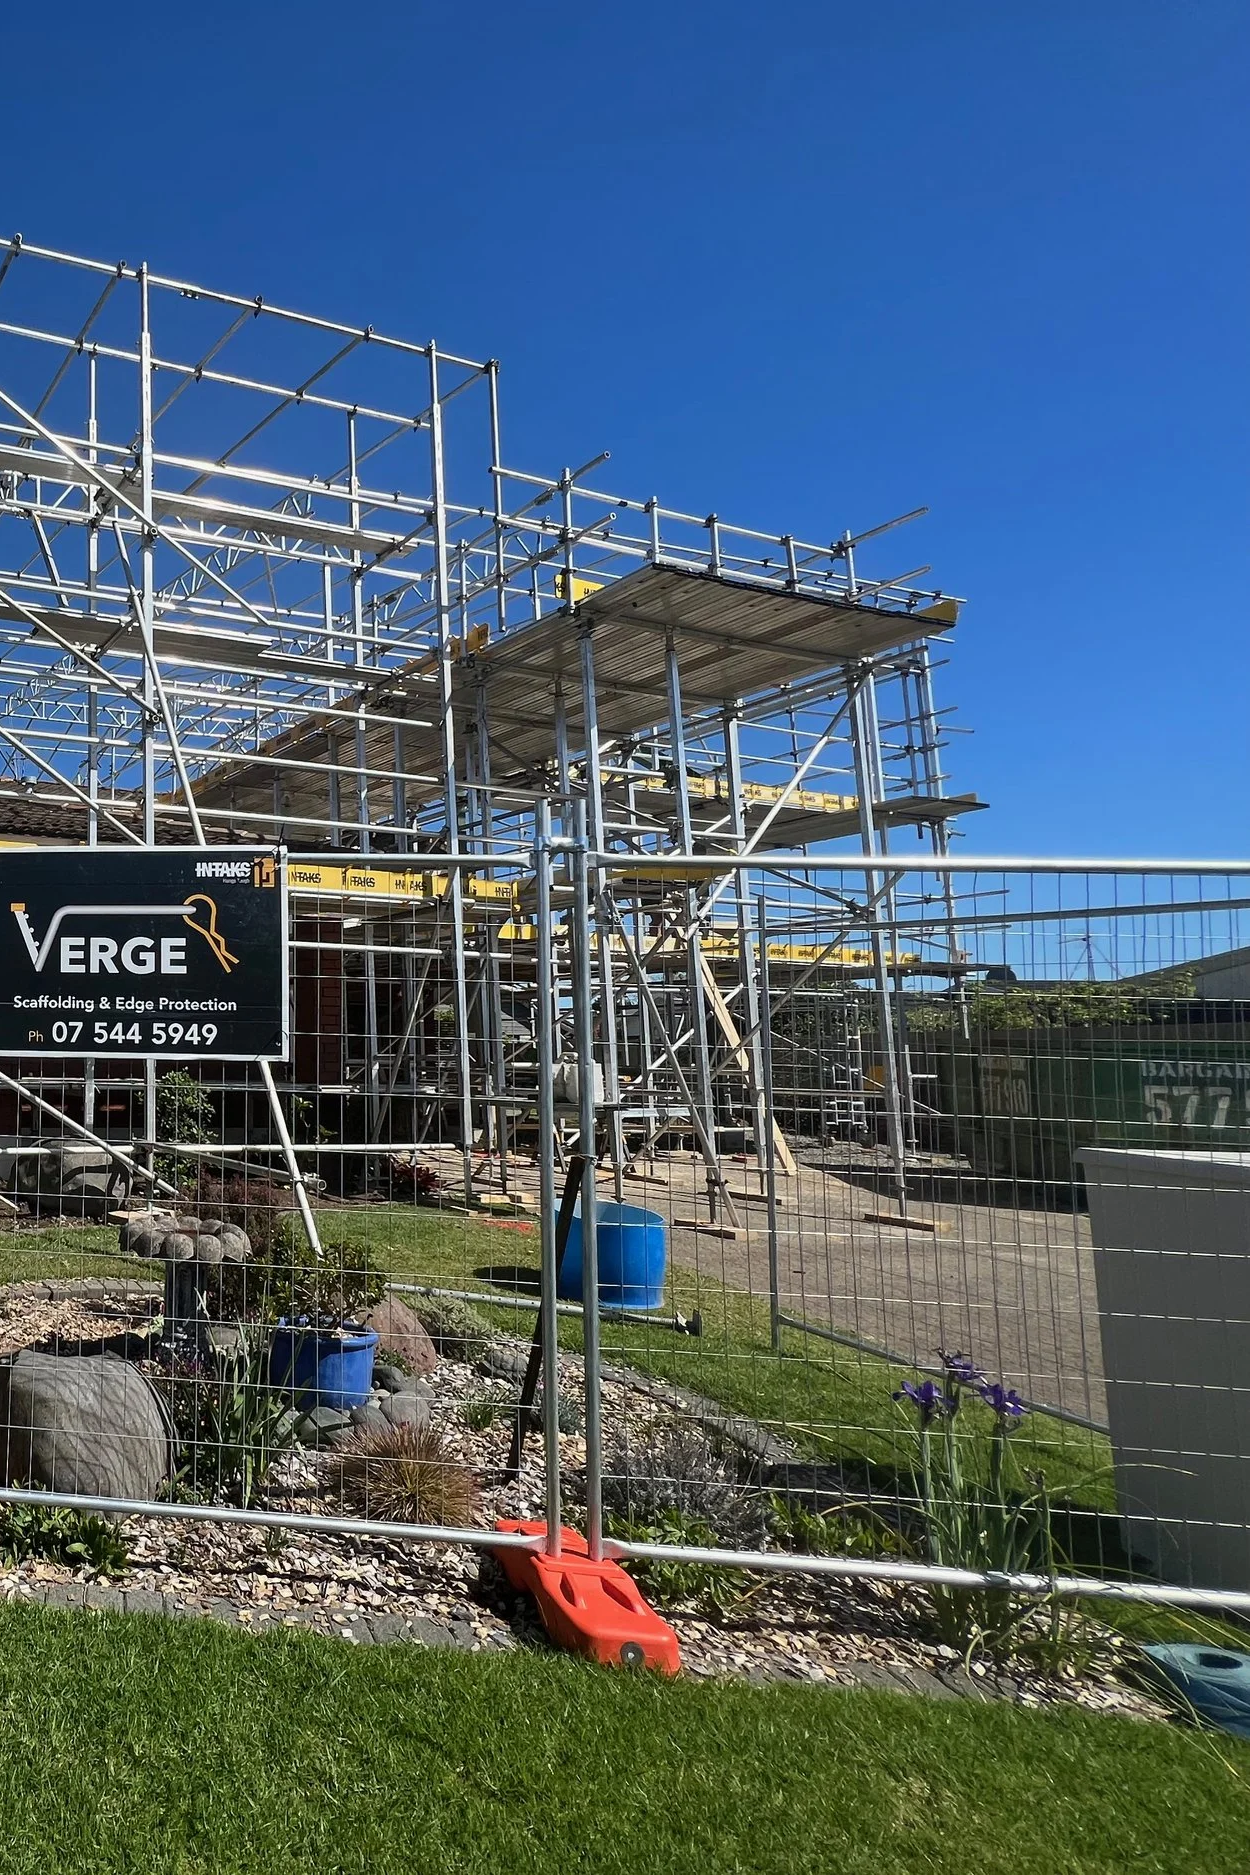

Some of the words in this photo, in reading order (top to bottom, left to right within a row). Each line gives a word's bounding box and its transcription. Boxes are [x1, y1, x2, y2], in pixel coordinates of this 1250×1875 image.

[195, 862, 251, 877] INTAKS
[290, 871, 322, 884] NTAKS
[10, 903, 197, 975] VERGE
[13, 995, 94, 1013] Scaffolding
[99, 997, 111, 1010] &
[115, 996, 154, 1013] Edge
[159, 997, 237, 1012] Protection
[28, 1030, 44, 1043] Ph
[51, 1021, 83, 1044] 07
[93, 1022, 142, 1045] 544
[151, 1022, 218, 1046] 5949
